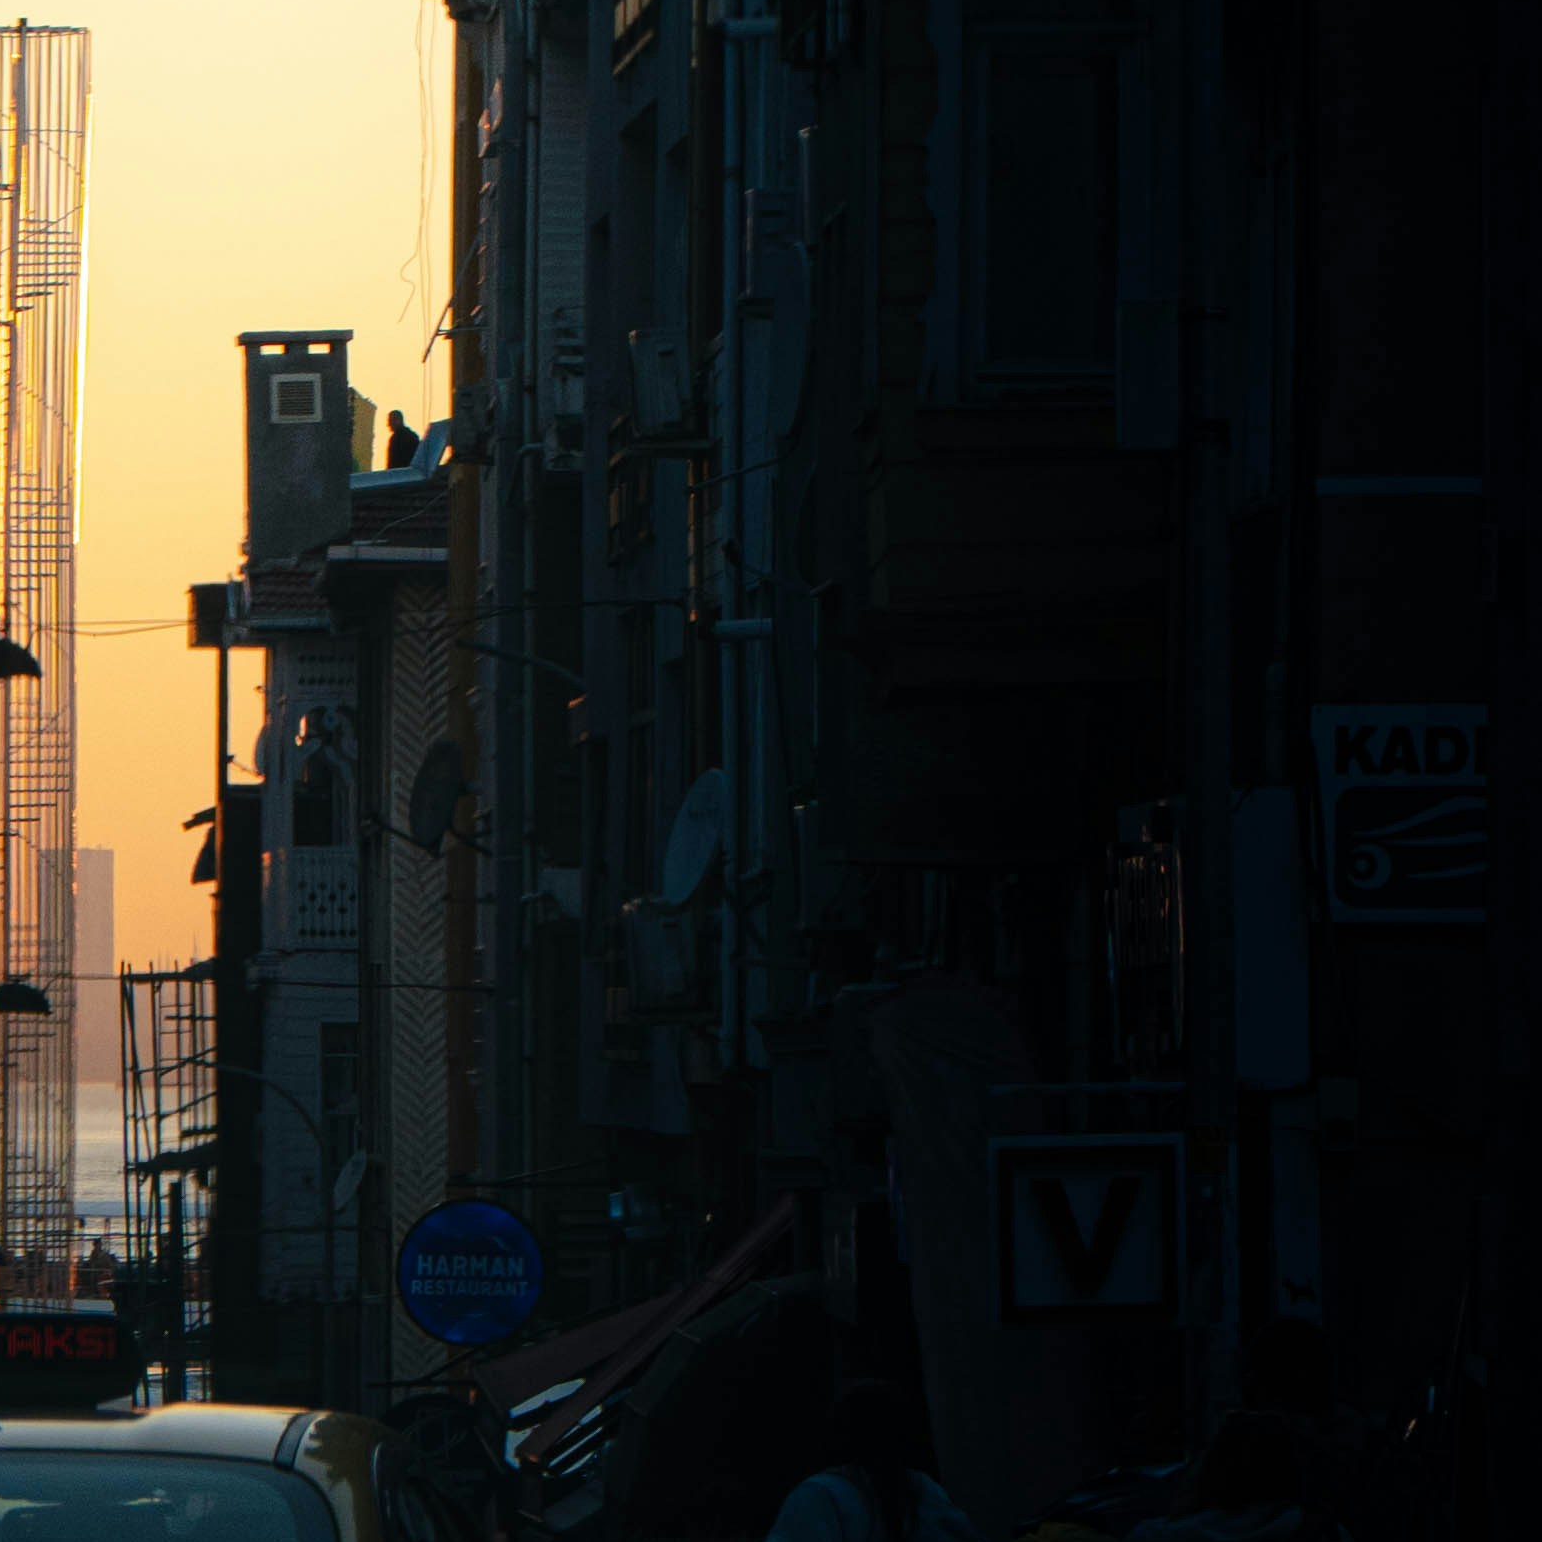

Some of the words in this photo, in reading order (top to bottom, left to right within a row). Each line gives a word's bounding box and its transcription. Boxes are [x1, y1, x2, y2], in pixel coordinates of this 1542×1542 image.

[1031, 1176, 1141, 1295] V
[416, 1254, 525, 1277] HARMAN
[410, 1279, 529, 1297] RESTAURANT
